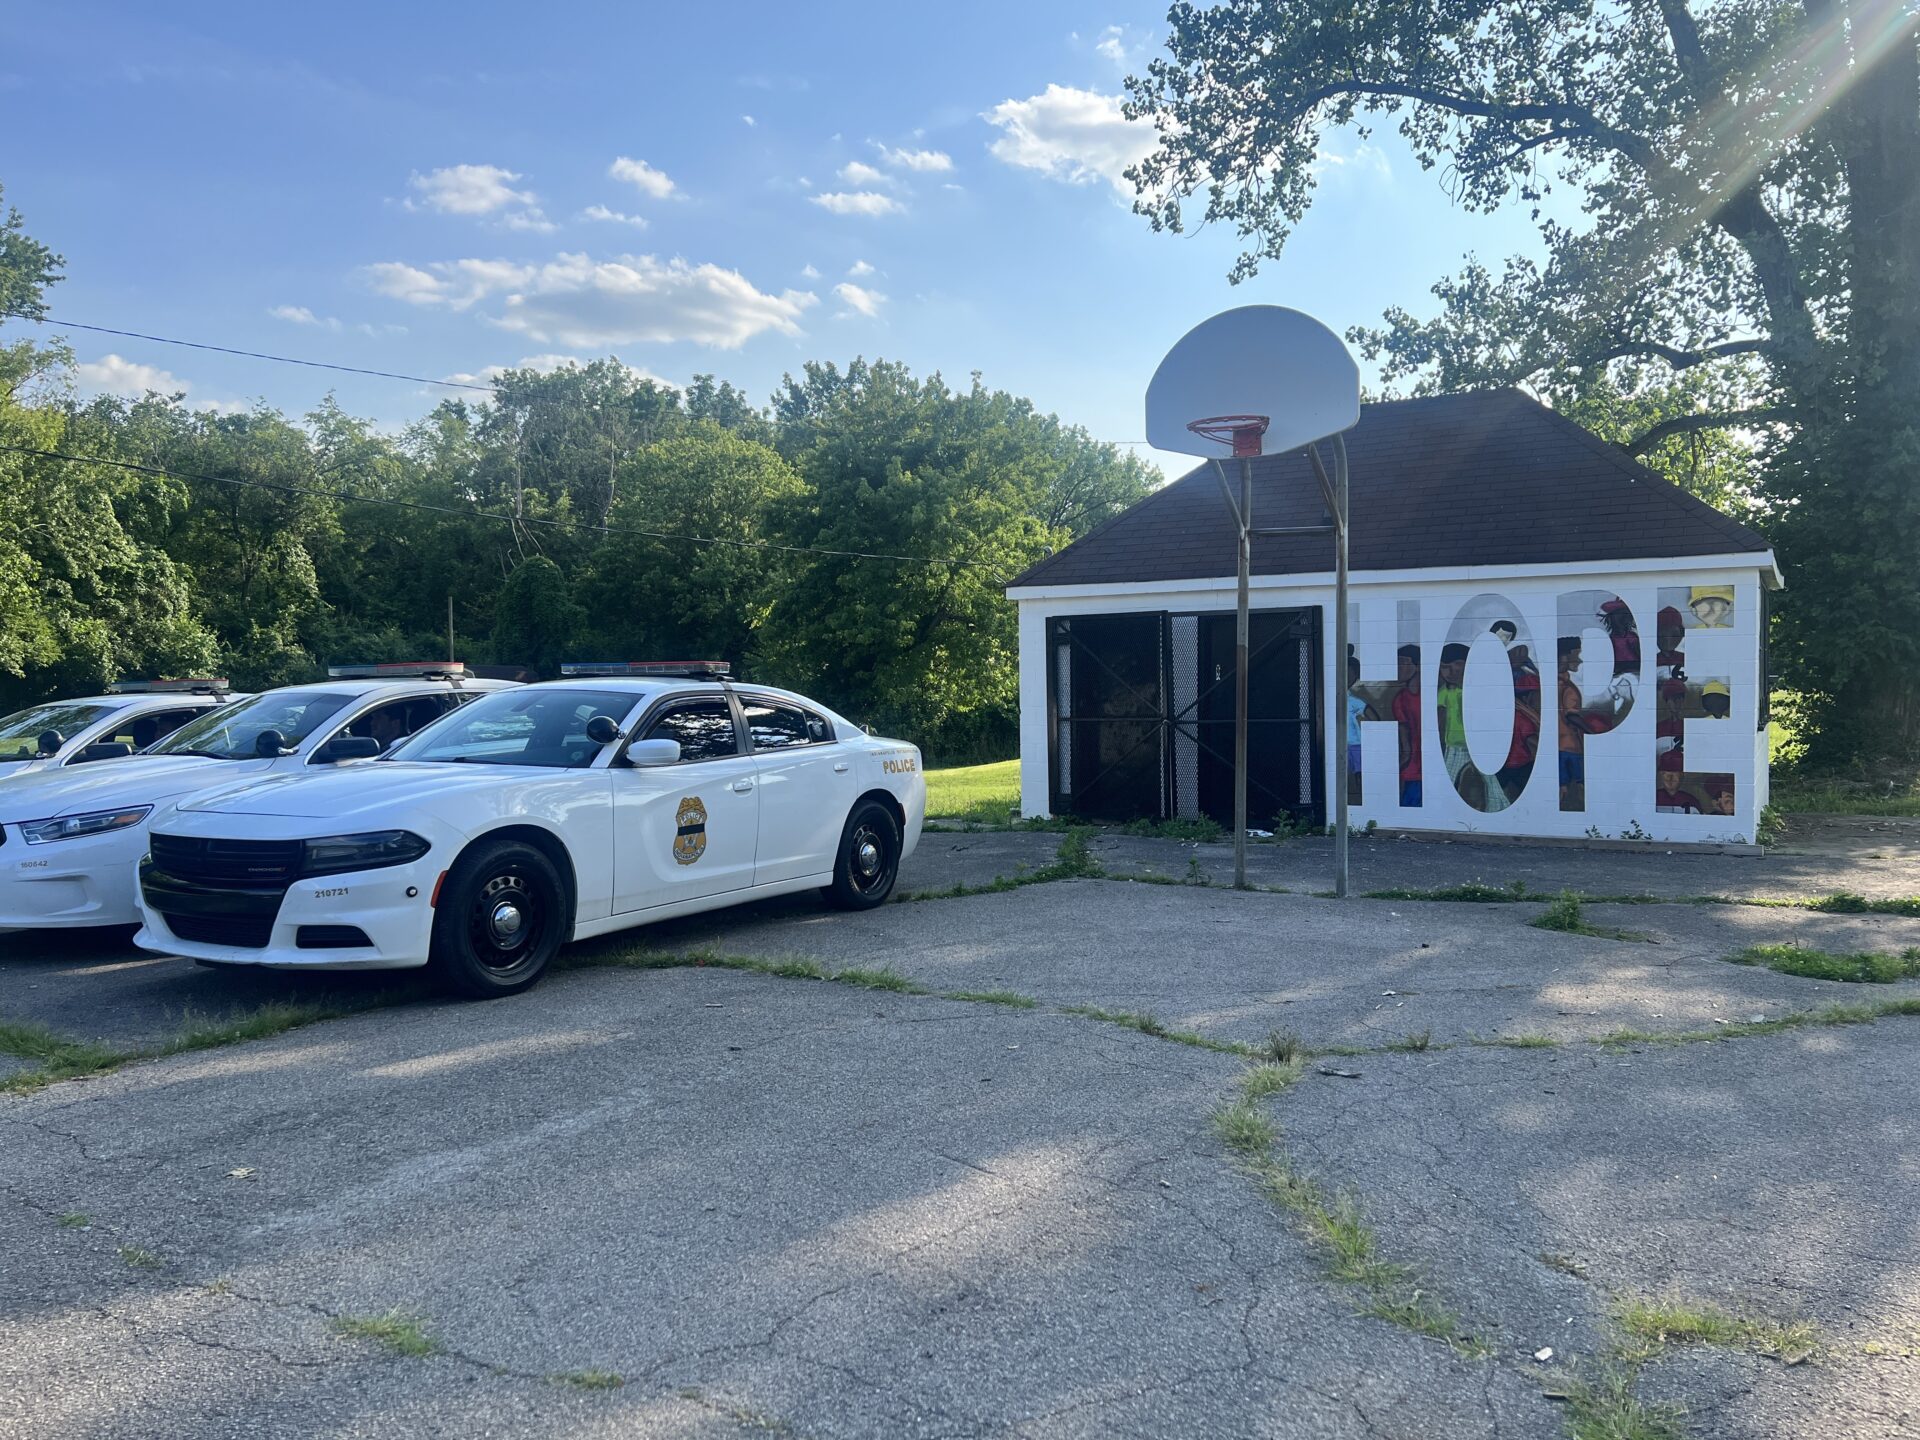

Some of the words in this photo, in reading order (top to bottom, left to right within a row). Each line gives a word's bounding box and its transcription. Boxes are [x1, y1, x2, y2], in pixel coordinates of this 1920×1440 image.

[1347, 585, 1735, 816] HOPE
[882, 758, 916, 774] POLICE
[314, 887, 349, 898] 210721
